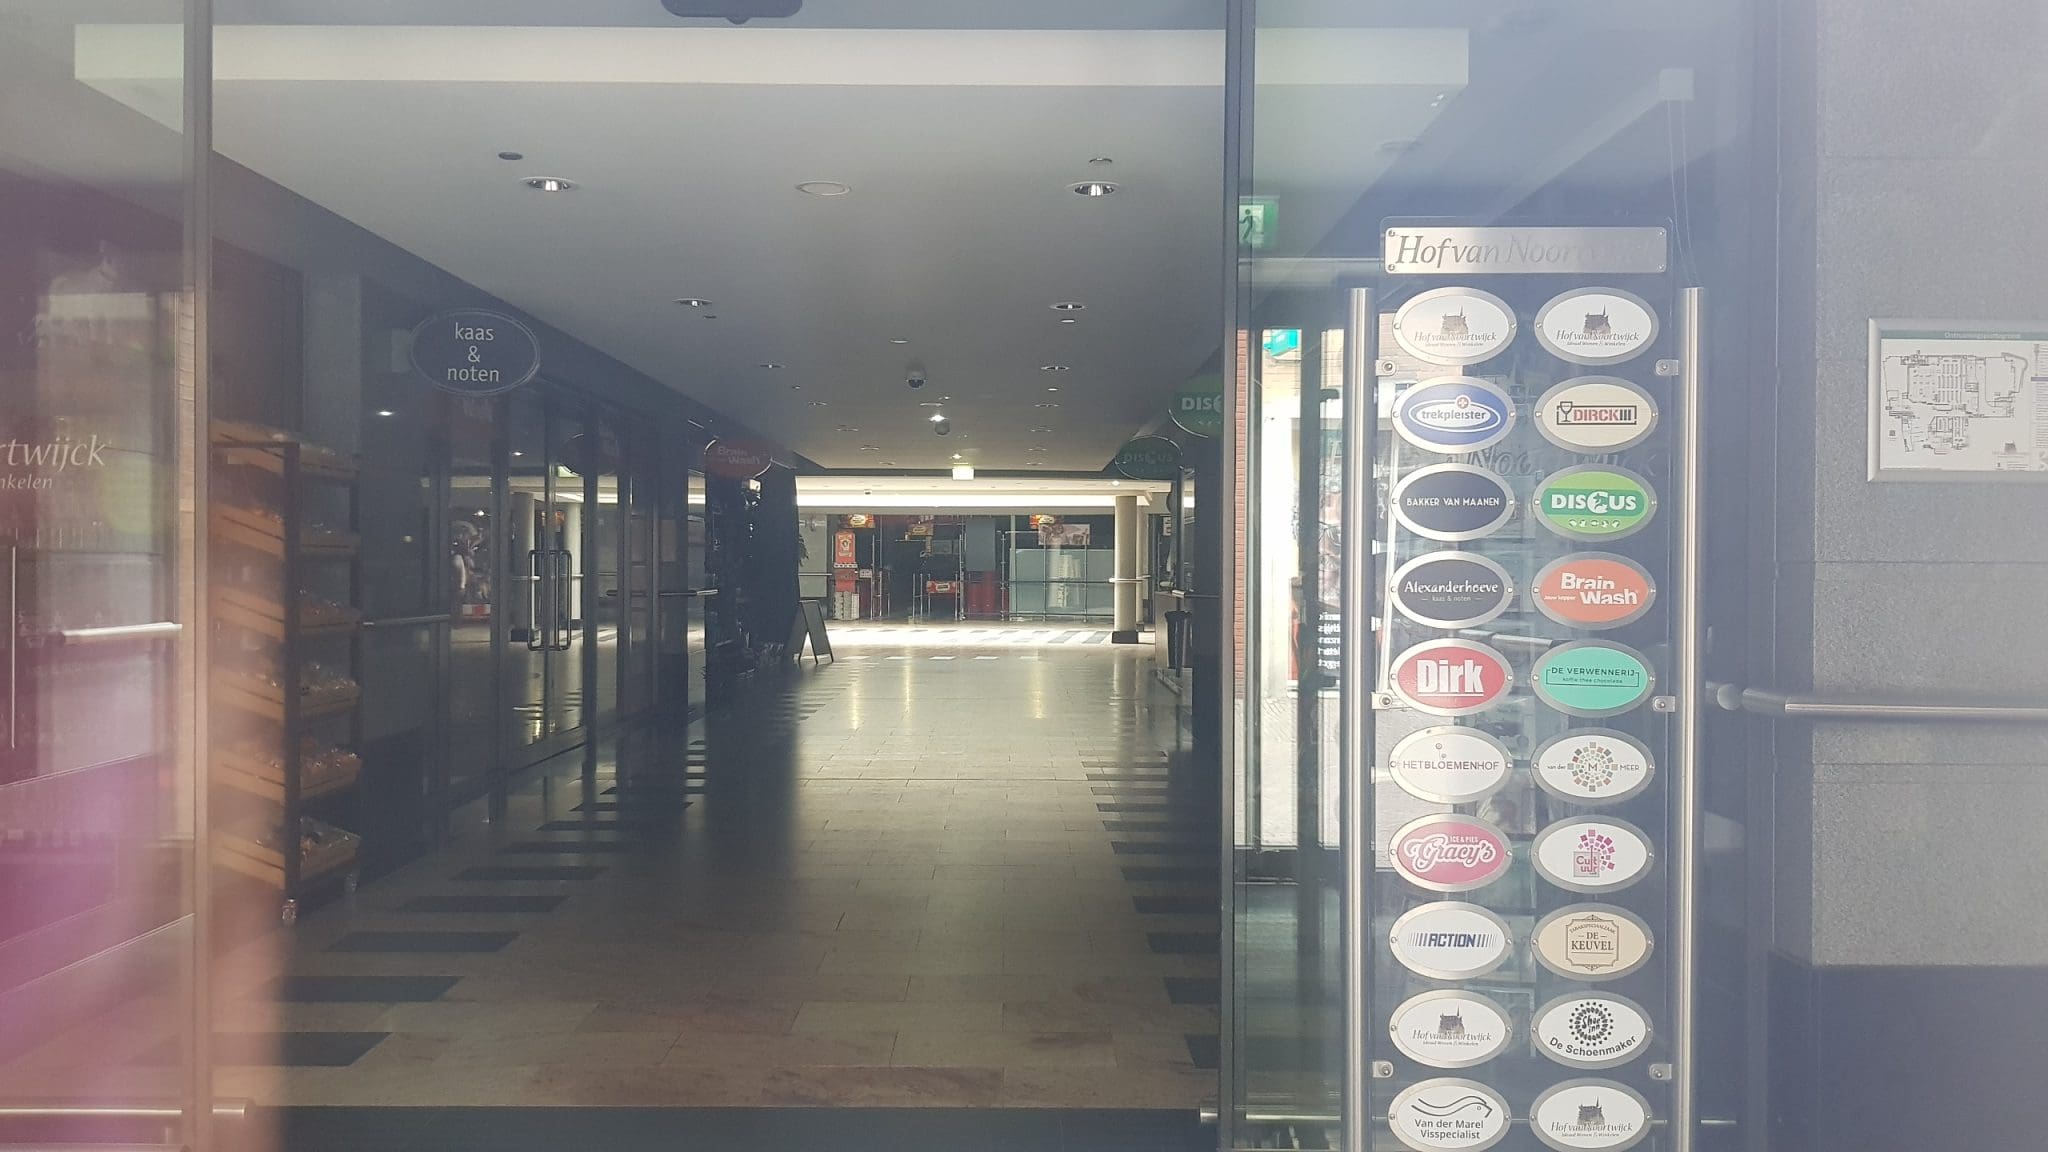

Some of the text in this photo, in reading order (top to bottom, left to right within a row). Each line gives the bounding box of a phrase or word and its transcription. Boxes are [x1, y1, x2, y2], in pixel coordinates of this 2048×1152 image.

[1395, 235, 1452, 268] Hof
[1452, 245, 1499, 264] van
[455, 322, 494, 341] kaas
[1556, 330, 1575, 342] Hof
[467, 345, 480, 362] &
[447, 365, 499, 382] noten
[1421, 409, 1487, 422] trekpleister
[1406, 497, 1500, 506] BAKKER VAN MAANEN
[1551, 491, 1637, 514] DISCUS
[1404, 580, 1499, 593] Alexanderhoeve
[1561, 572, 1615, 590] Brain
[1580, 589, 1638, 605] Wash
[1416, 659, 1484, 693] Dirk
[1566, 667, 1635, 677] VERWENNERIJ
[1402, 760, 1501, 771] HETBLOEMENHOF
[1428, 933, 1476, 948] ACTION
[1586, 931, 1599, 940] DE
[1571, 940, 1614, 951] KEUVEL
[1549, 1035, 1636, 1057] De Schoenmaker
[1414, 1118, 1484, 1130] Van der Marel
[1551, 1121, 1570, 1133] Hof
[1420, 1129, 1481, 1141] Visspecialist
